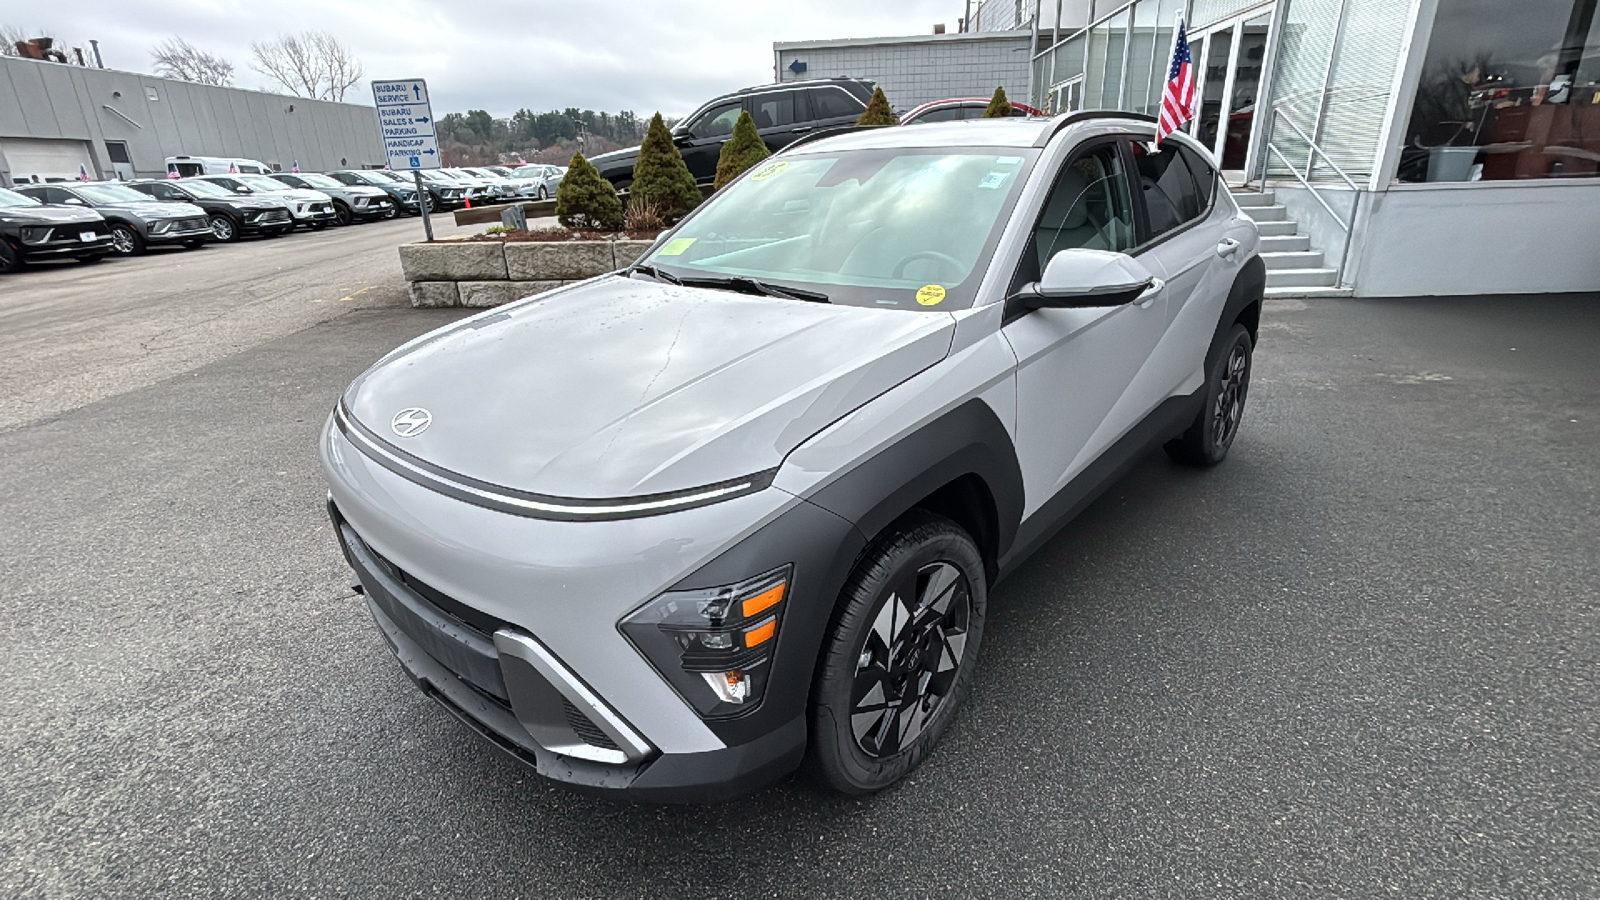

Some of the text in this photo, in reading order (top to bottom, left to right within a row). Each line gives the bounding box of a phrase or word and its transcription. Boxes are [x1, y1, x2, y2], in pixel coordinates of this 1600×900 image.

[376, 84, 406, 92] SUBARU
[378, 94, 409, 102] SERVICE
[382, 108, 411, 116] SUBARU
[388, 139, 424, 147] HANDICAP
